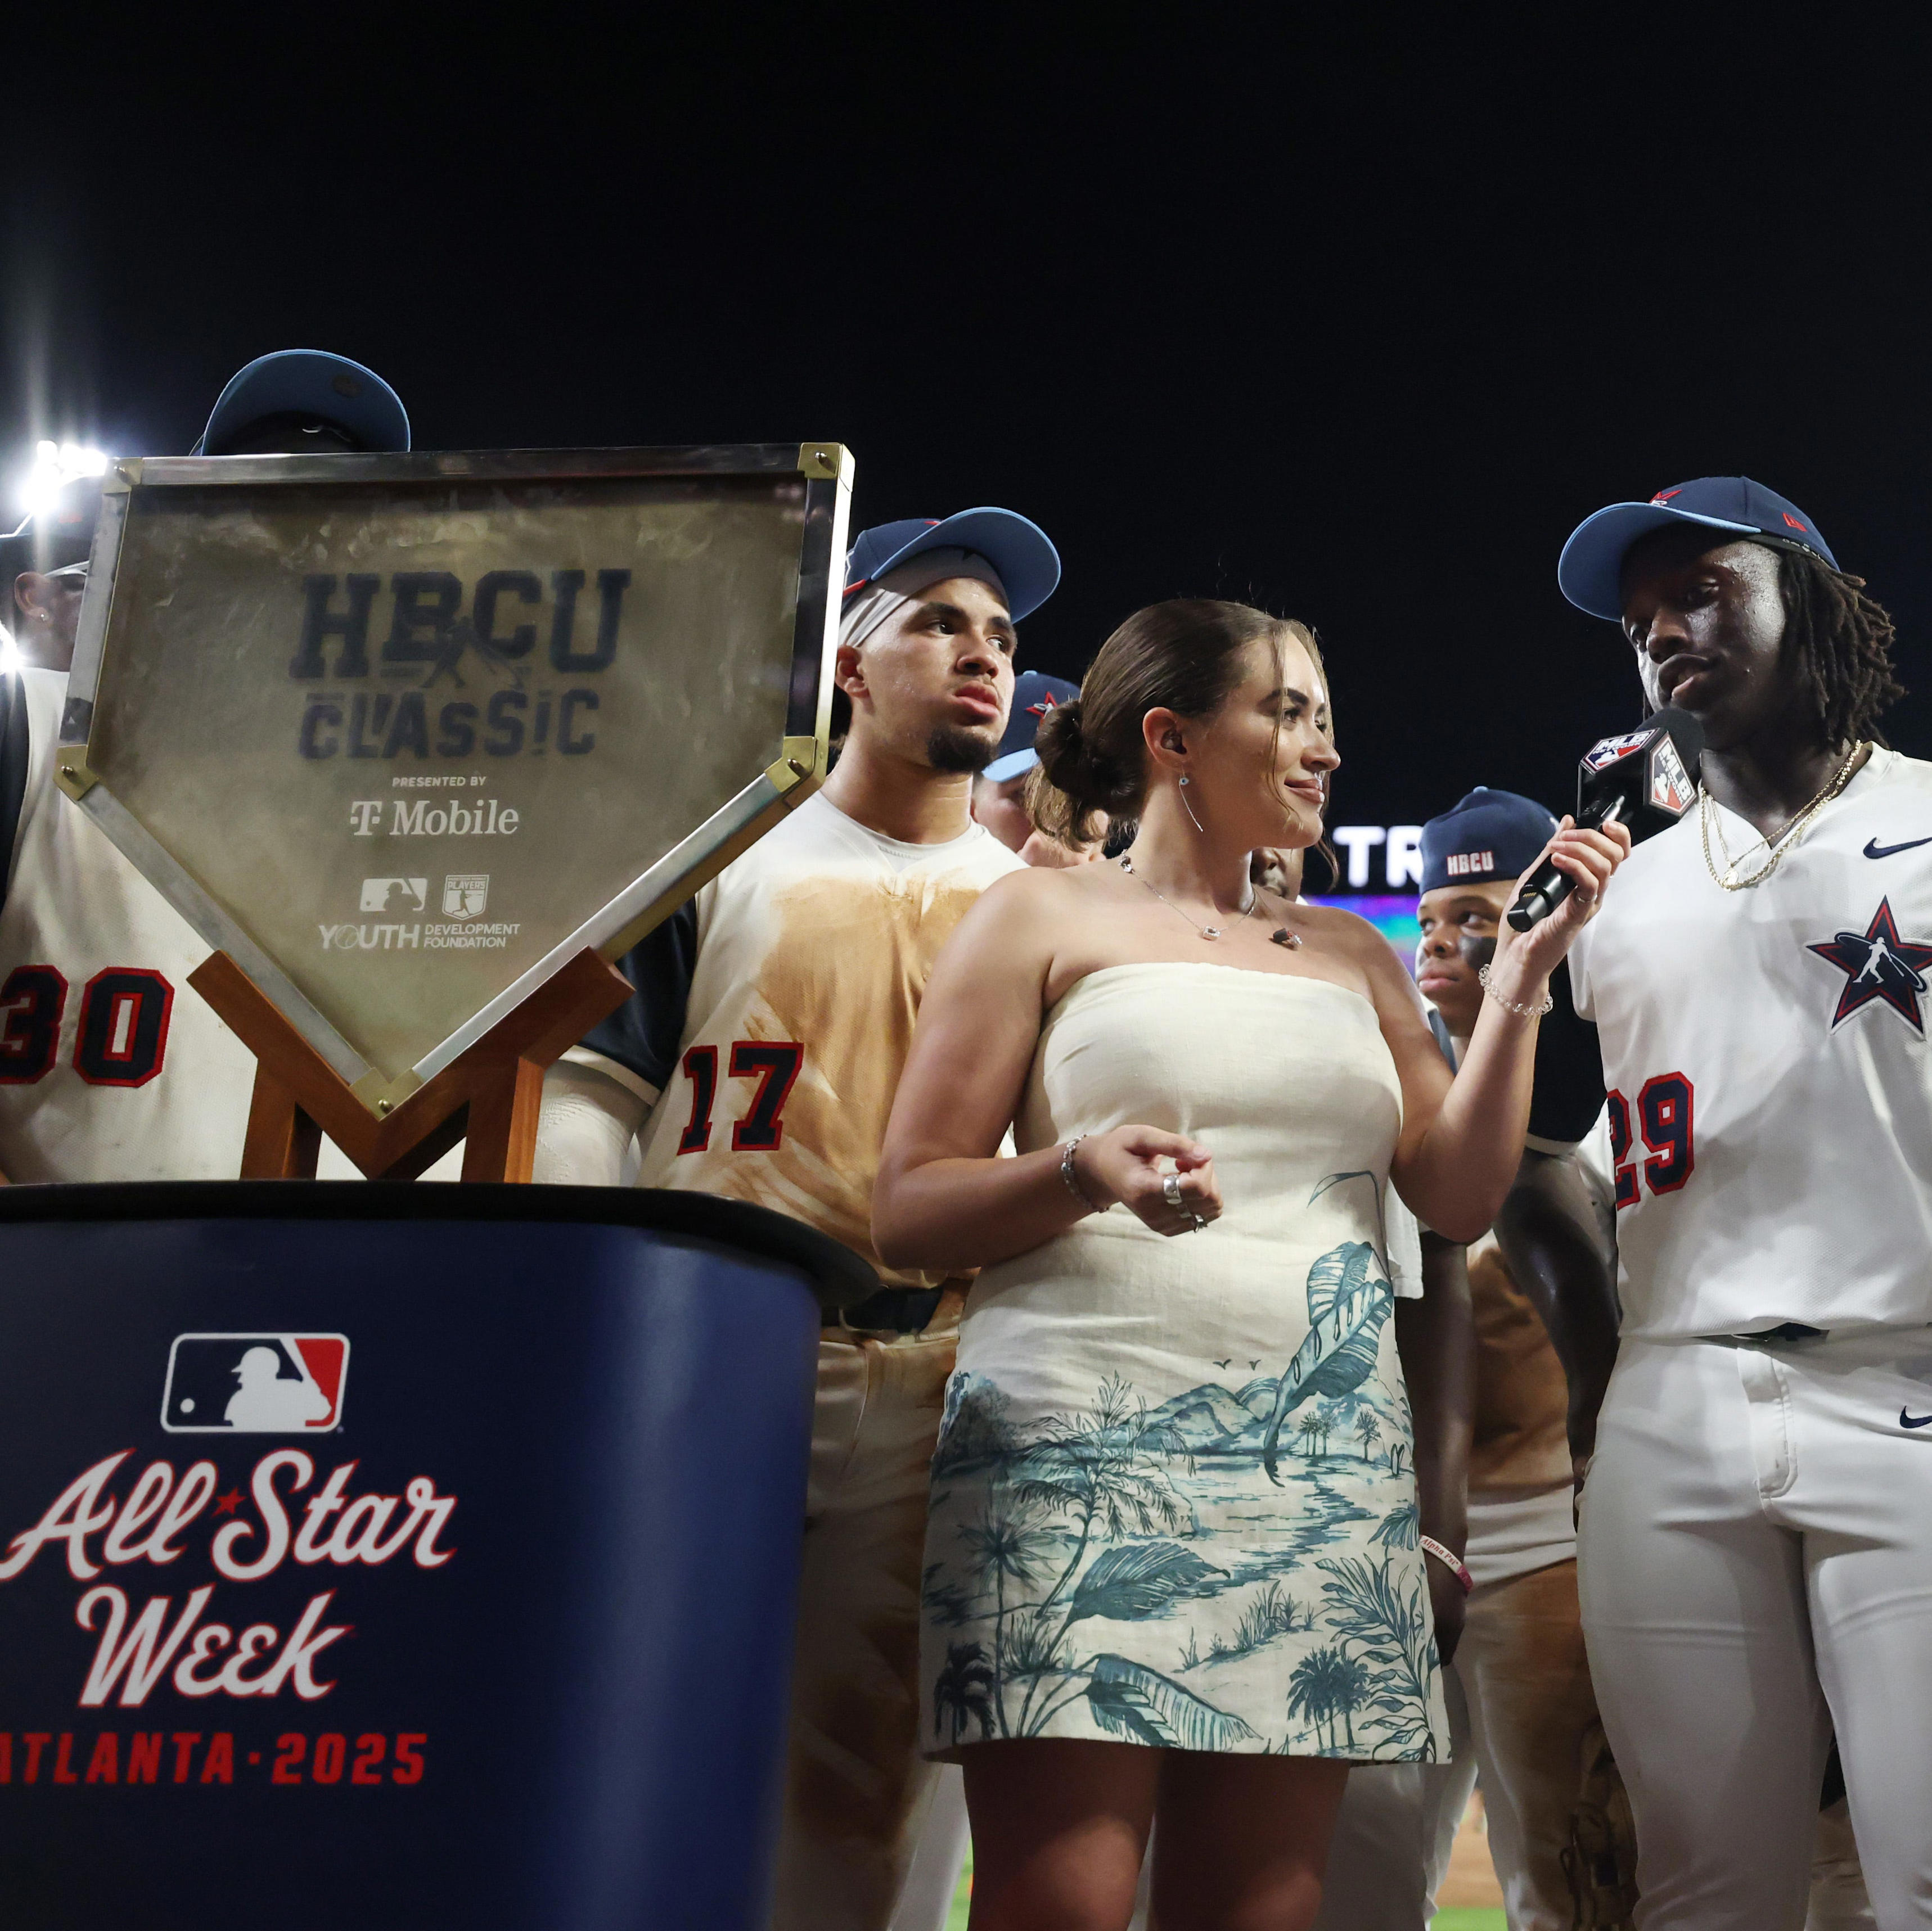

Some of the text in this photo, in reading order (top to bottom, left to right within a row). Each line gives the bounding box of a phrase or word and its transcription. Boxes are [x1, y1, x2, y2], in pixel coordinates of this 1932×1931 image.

[289, 569, 632, 678] HBCU
[298, 689, 600, 759] CLASSIC
[1596, 732, 1650, 750] MLB
[393, 776, 487, 787] PRESENTED BY
[1660, 742, 1691, 801] MLB
[389, 799, 520, 836] Mobile
[1446, 850, 1494, 876] HBCU
[448, 881, 486, 890] PLAYERS
[318, 924, 420, 949] YOUTH
[424, 936, 506, 948] FOUNDATION
[425, 923, 520, 935] DEVELOPMENT
[0, 965, 175, 1088] 30
[676, 1040, 804, 1156] 17
[0, 1447, 458, 1581] All Star
[1420, 1539, 1444, 1555] Alpha
[75, 1582, 354, 1708] Week
[272, 1733, 428, 1785] 2025
